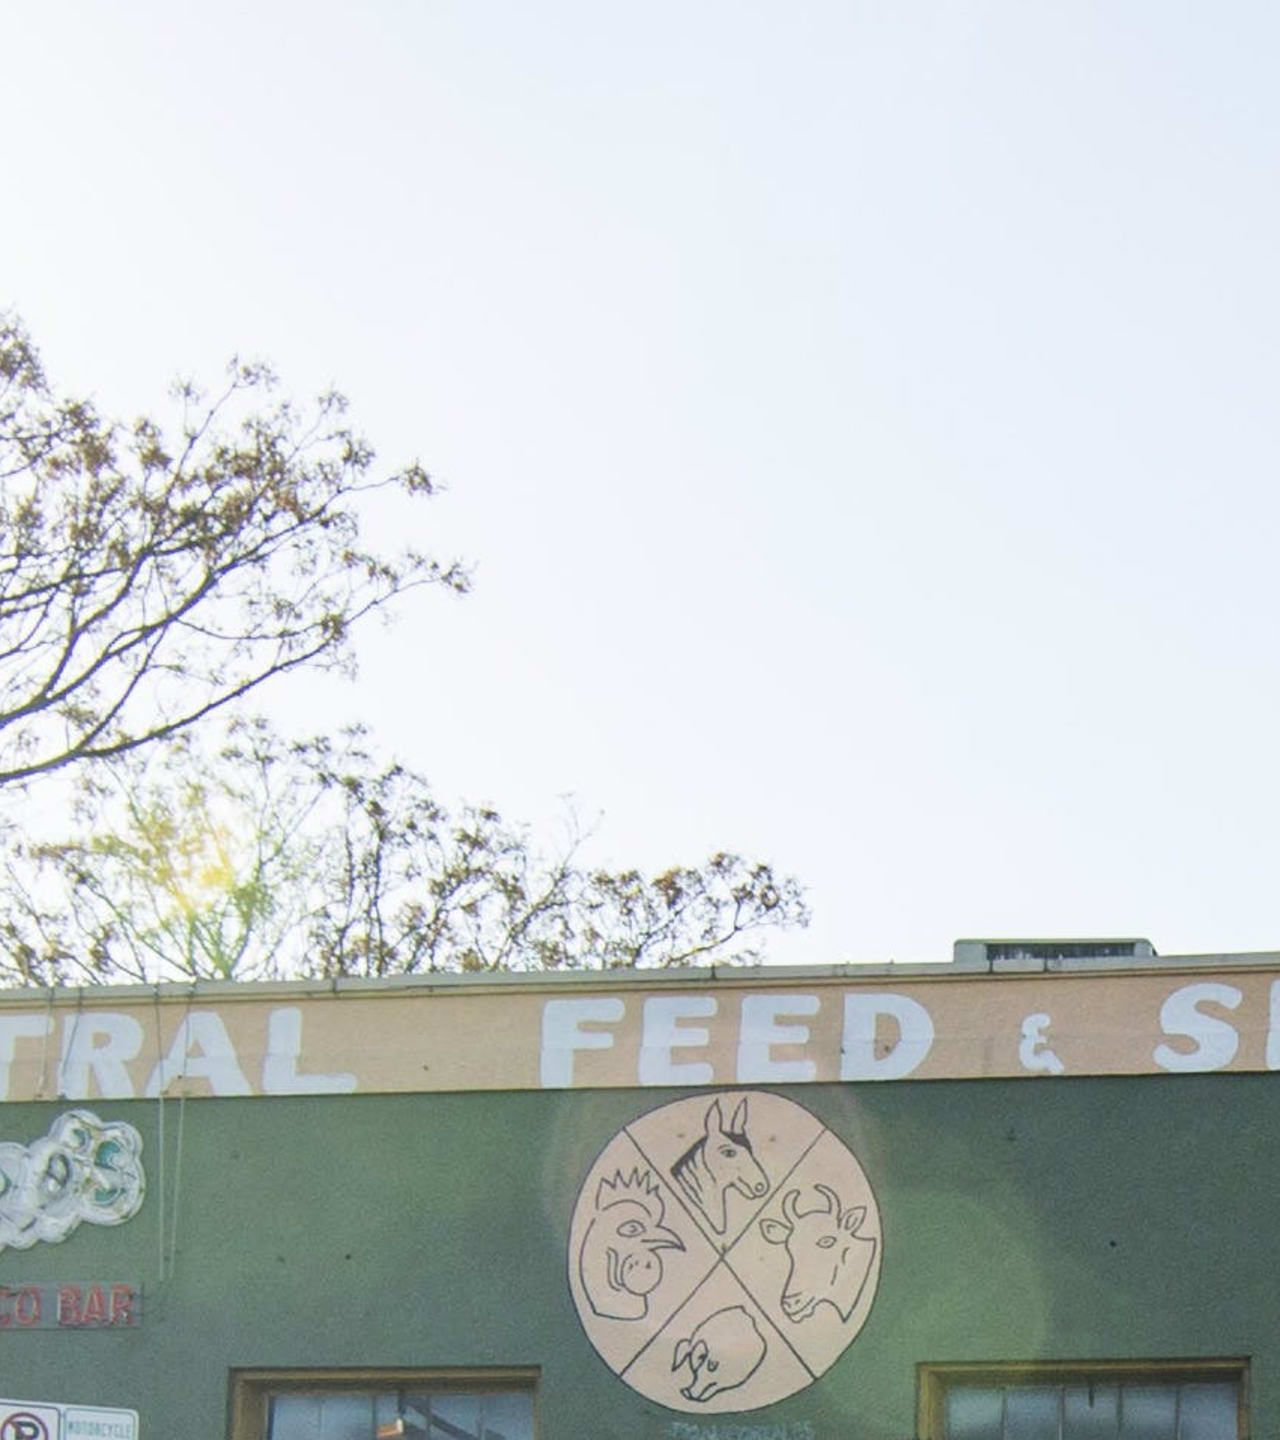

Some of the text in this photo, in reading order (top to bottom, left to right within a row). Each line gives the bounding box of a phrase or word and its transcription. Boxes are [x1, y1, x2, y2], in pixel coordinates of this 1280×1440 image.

[540, 993, 935, 1088] FEED
[1018, 1012, 1064, 1075] &
[56, 1283, 134, 1327] BAR
